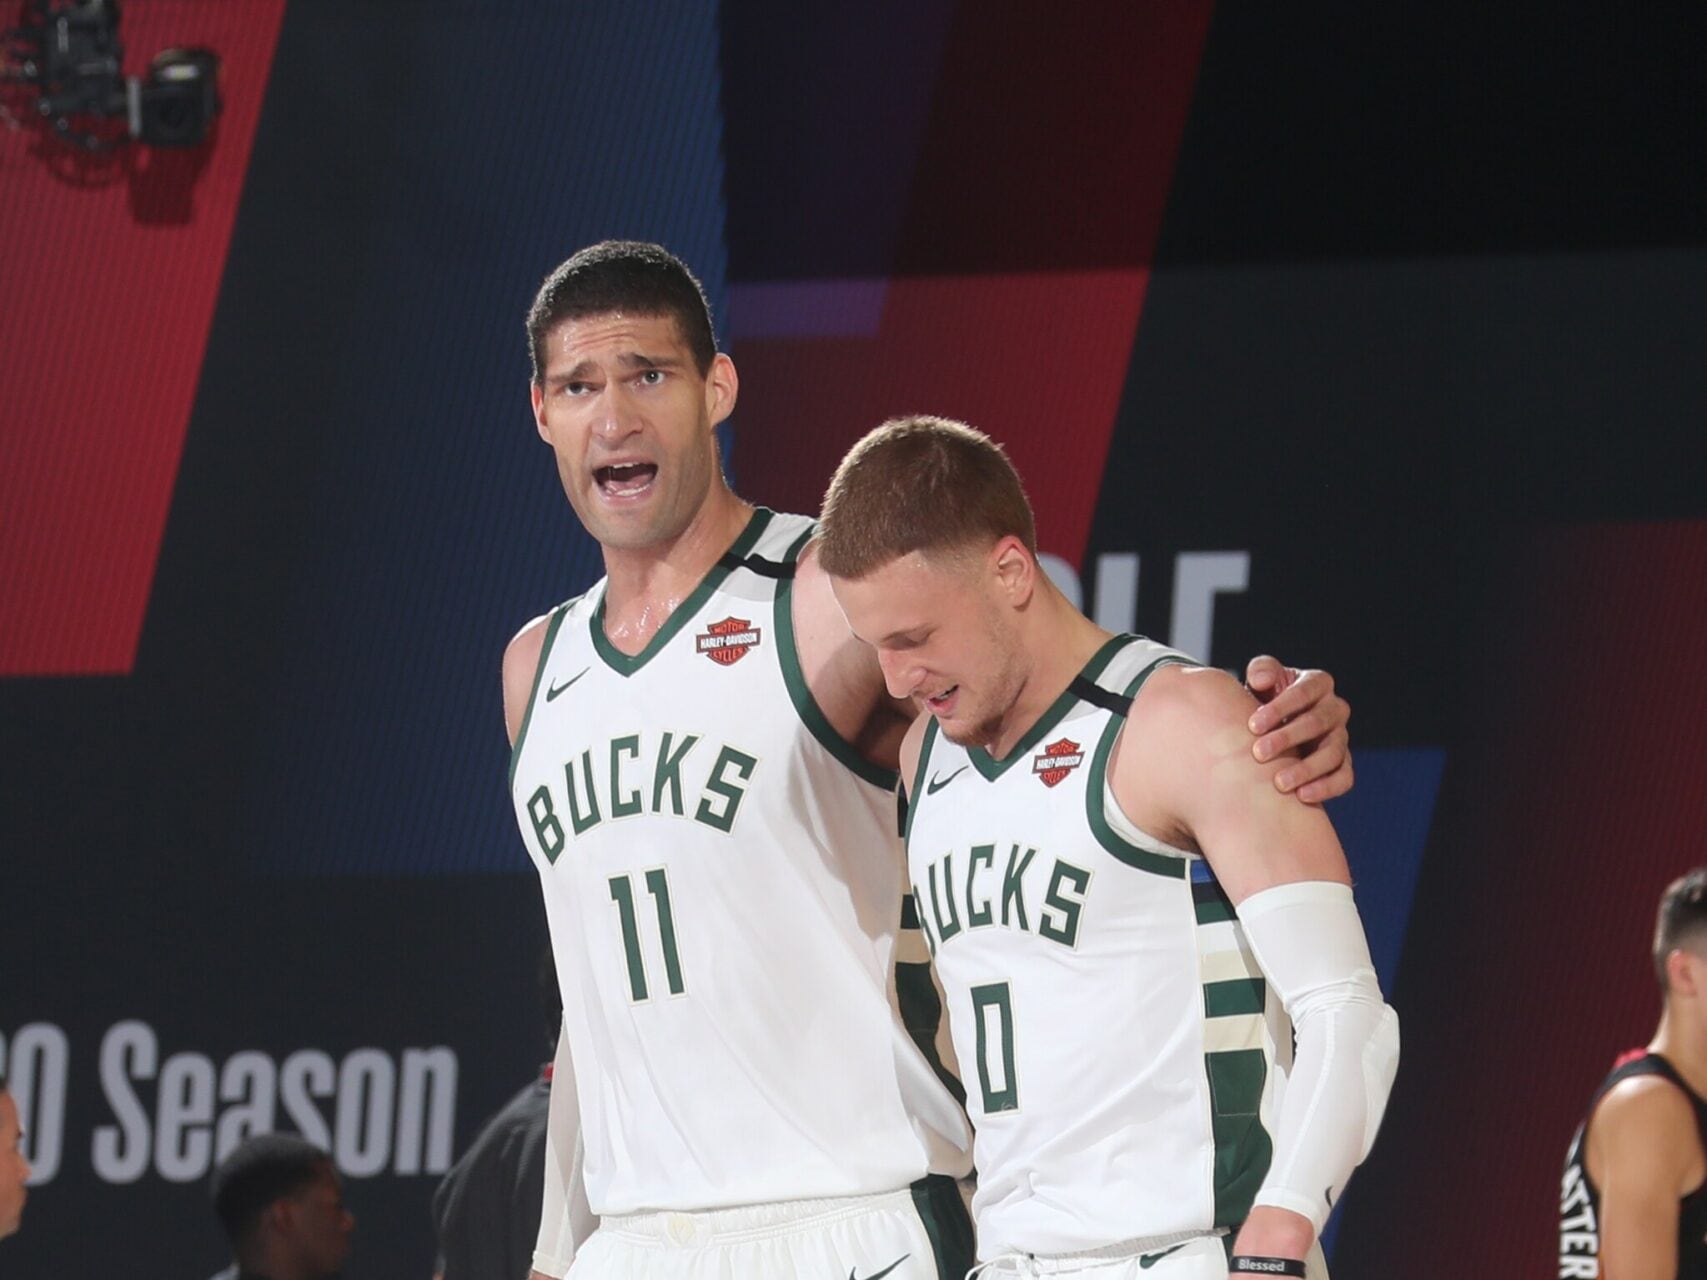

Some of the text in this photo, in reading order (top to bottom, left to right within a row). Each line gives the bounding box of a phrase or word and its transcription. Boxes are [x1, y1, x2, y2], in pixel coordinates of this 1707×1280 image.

[526, 731, 759, 867] BUCKS
[607, 868, 686, 1003] 11
[912, 843, 1092, 961] UCKS
[91, 1018, 459, 1184] Season
[969, 981, 1020, 1114] 0
[1238, 1259, 1285, 1272] Blessed
